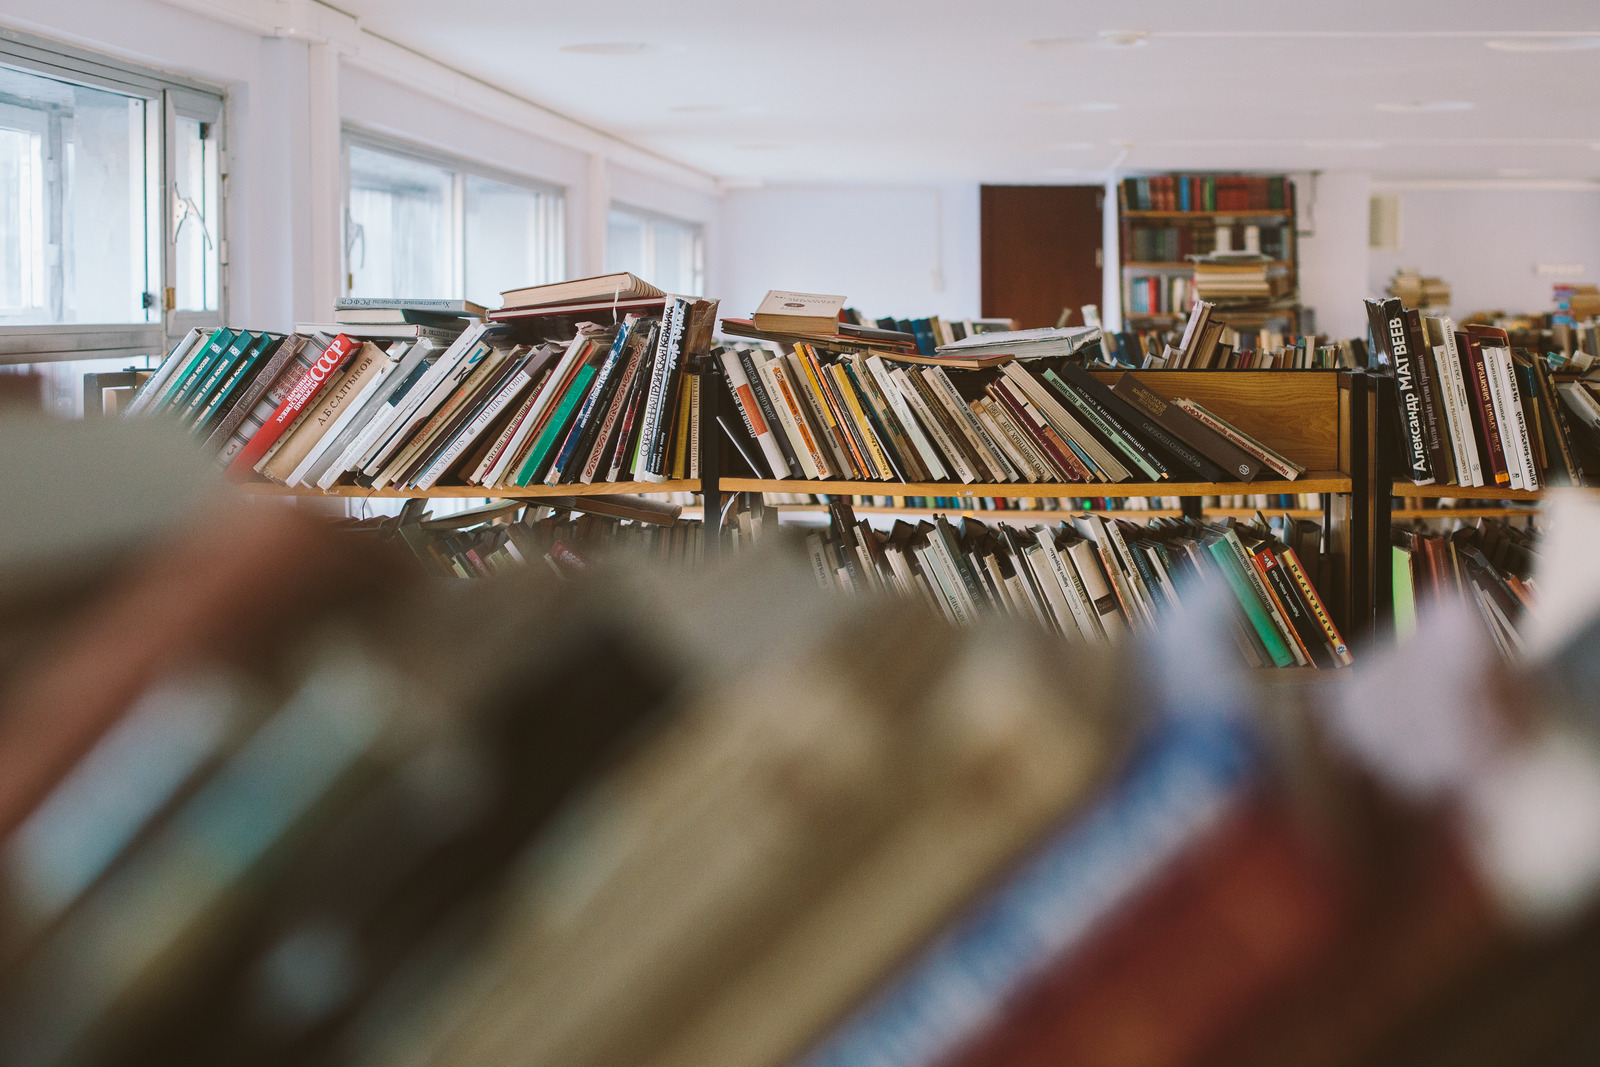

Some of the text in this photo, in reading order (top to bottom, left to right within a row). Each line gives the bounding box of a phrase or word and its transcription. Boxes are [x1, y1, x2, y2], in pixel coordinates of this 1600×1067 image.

[306, 338, 348, 383] СССР
[639, 304, 675, 457] СОВРЕМЕННАЯ ГРУЗИНСКАЯ КЕРАМИКА
[276, 376, 314, 423] ХУДОЖЕСТВЕННЫЕ
[285, 373, 310, 402] НАРОДНЫЕ
[292, 380, 319, 411] ПРОМЫСЛЫ
[476, 371, 527, 424] ШУШКАНОВЫ
[741, 356, 776, 421] ДОМОВАЯ РЕЗЬБА
[1051, 376, 1114, 437] ВЫПИЛИВАНИЕ ЛОБЗИКОМ
[1182, 403, 1203, 419] РСФСР
[1388, 315, 1430, 473] Александр МАТВЕЕВ
[1474, 360, 1501, 452] ХРАМ ХРИСТА СПАСИТЕЛЯ
[409, 385, 469, 449] Народное искусство
[1201, 414, 1228, 435] промыслы
[418, 436, 465, 487] SHUSHKANOV
[1033, 461, 1046, 475] СТО
[1226, 431, 1266, 460] художественные
[1264, 456, 1289, 475] Народные
[957, 466, 967, 477] 300
[1230, 540, 1275, 613] ВЫПИЛИВАНИЕ ЛОБЗИКОМ
[1290, 563, 1337, 640] КАРИКАТУРЫ
